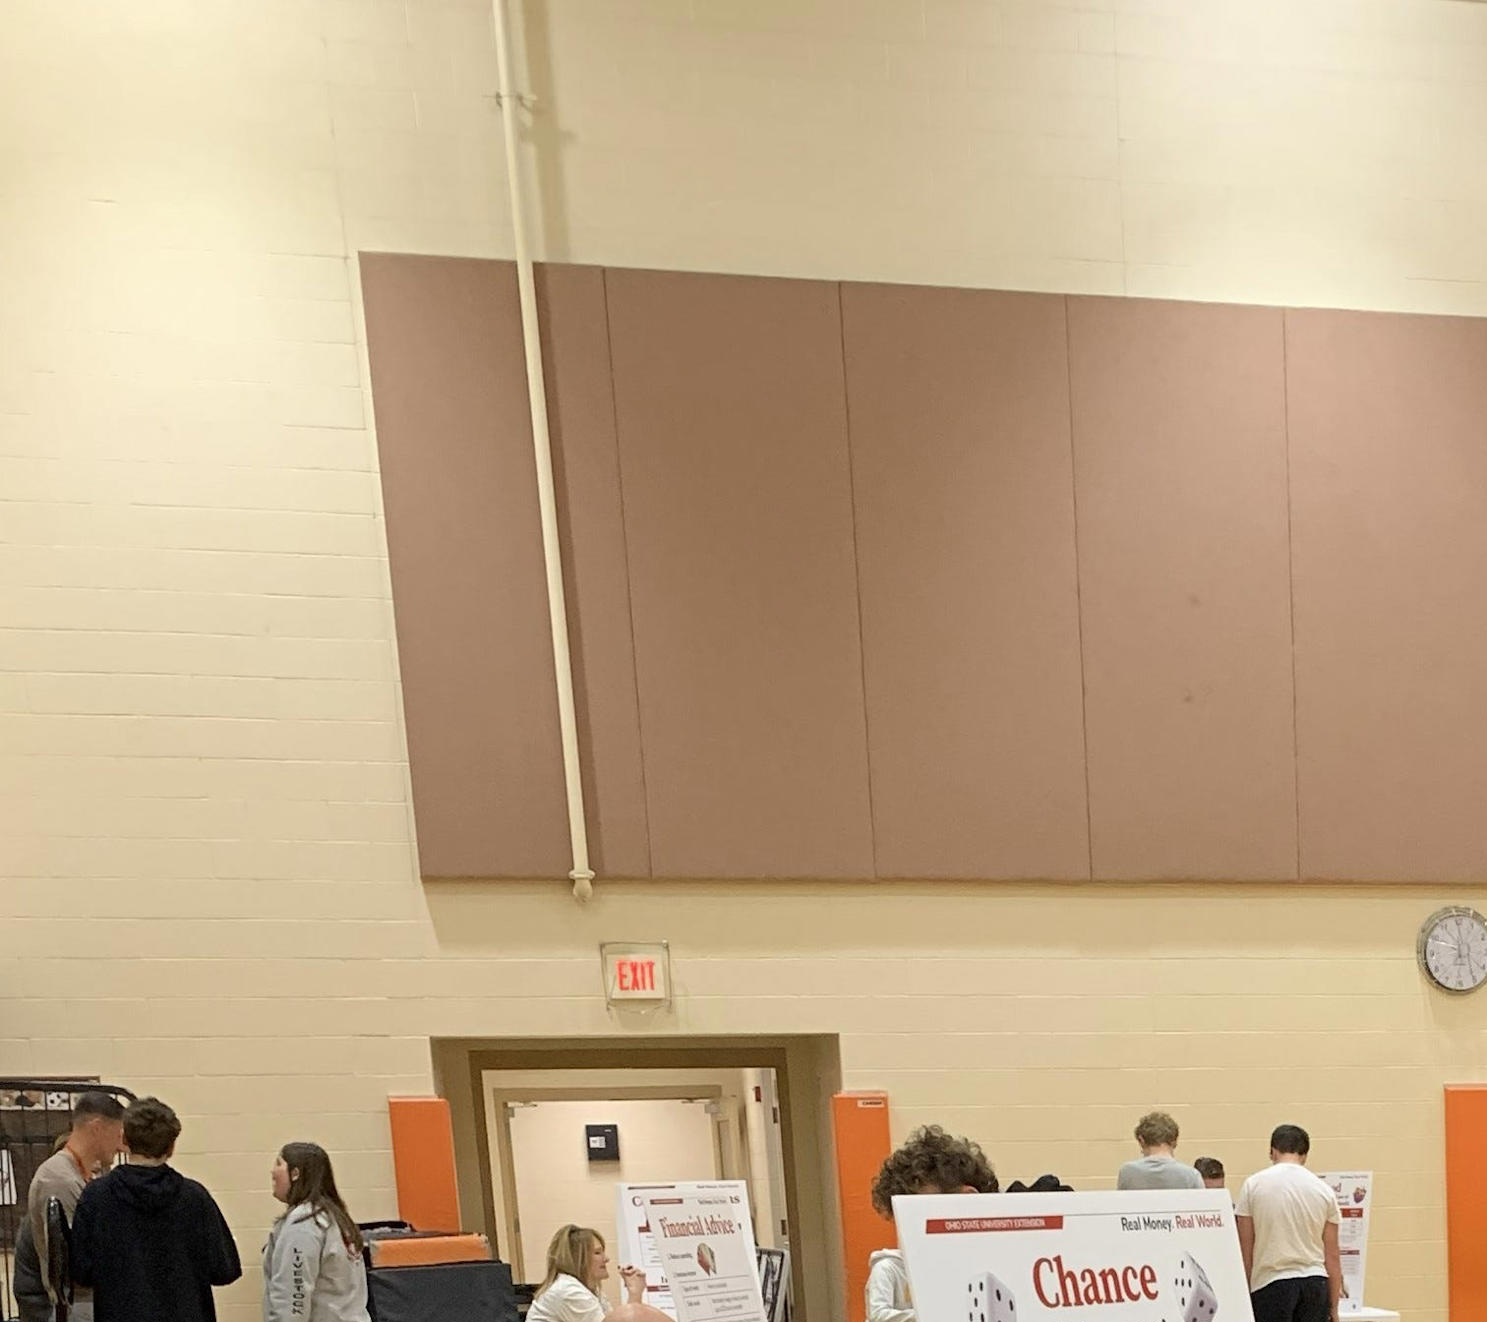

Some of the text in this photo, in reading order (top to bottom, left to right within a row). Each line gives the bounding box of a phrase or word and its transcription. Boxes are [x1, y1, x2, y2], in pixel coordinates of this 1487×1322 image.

[616, 960, 656, 991] EXIT
[659, 1214, 735, 1238] Financial Advice
[1121, 1213, 1224, 1232] Real Money. Real World.
[292, 1247, 305, 1316] LIVESTOCK
[1032, 1254, 1159, 1309] Chance
